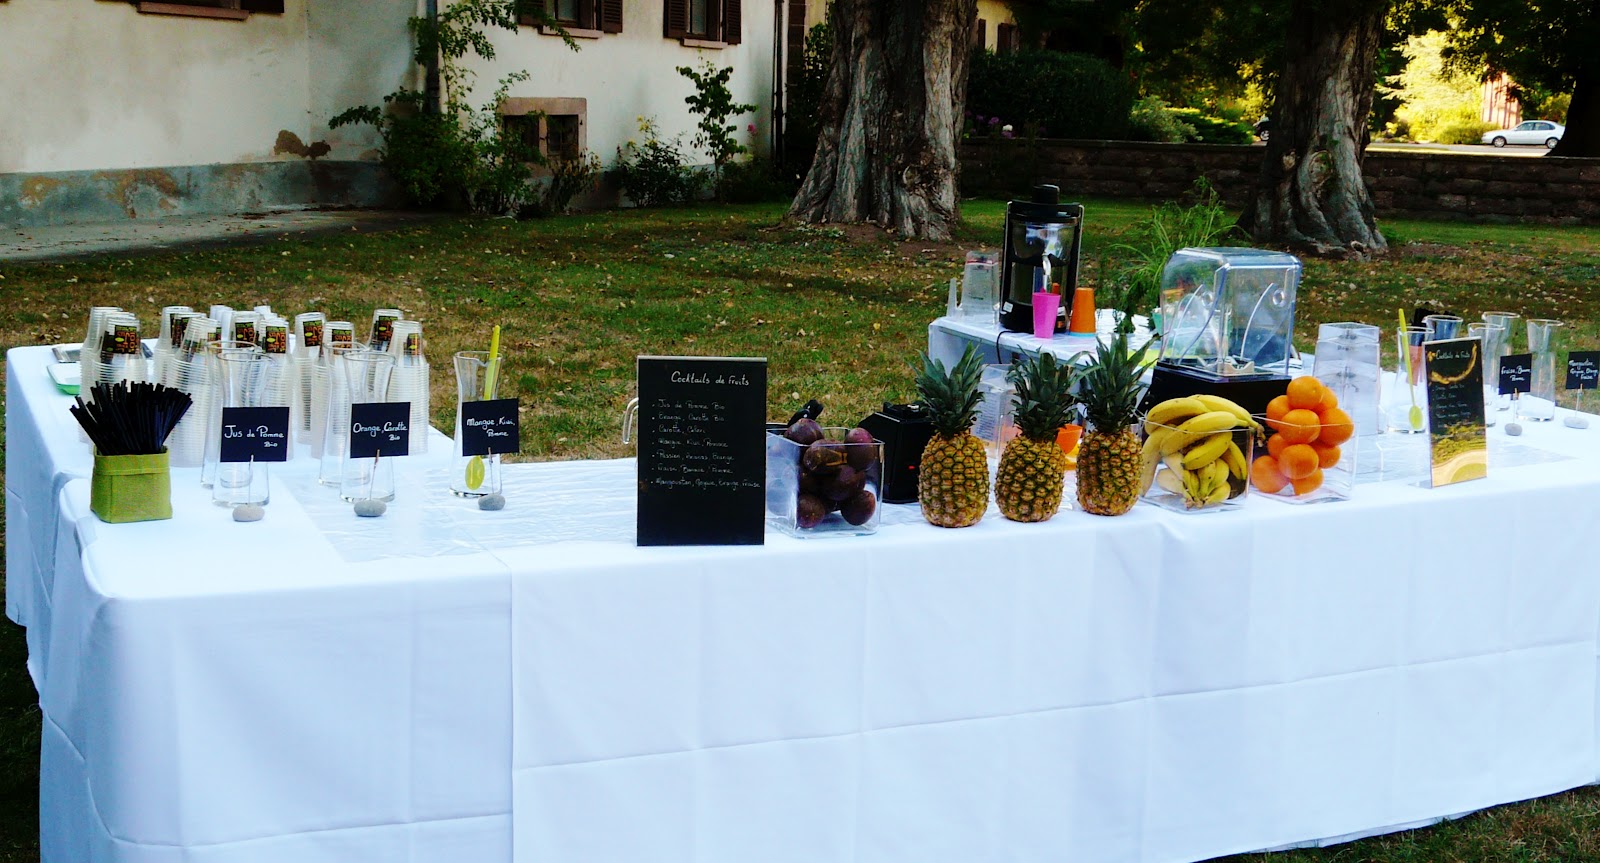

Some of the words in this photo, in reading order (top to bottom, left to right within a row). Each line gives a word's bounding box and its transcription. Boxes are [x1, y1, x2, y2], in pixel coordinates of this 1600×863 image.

[671, 371, 710, 385] Cocktails
[715, 375, 725, 384] de
[728, 374, 750, 386] Fruits
[224, 424, 243, 438] Jus
[246, 429, 255, 438] de
[256, 425, 284, 438] Pomme
[384, 421, 408, 432] Carotte
